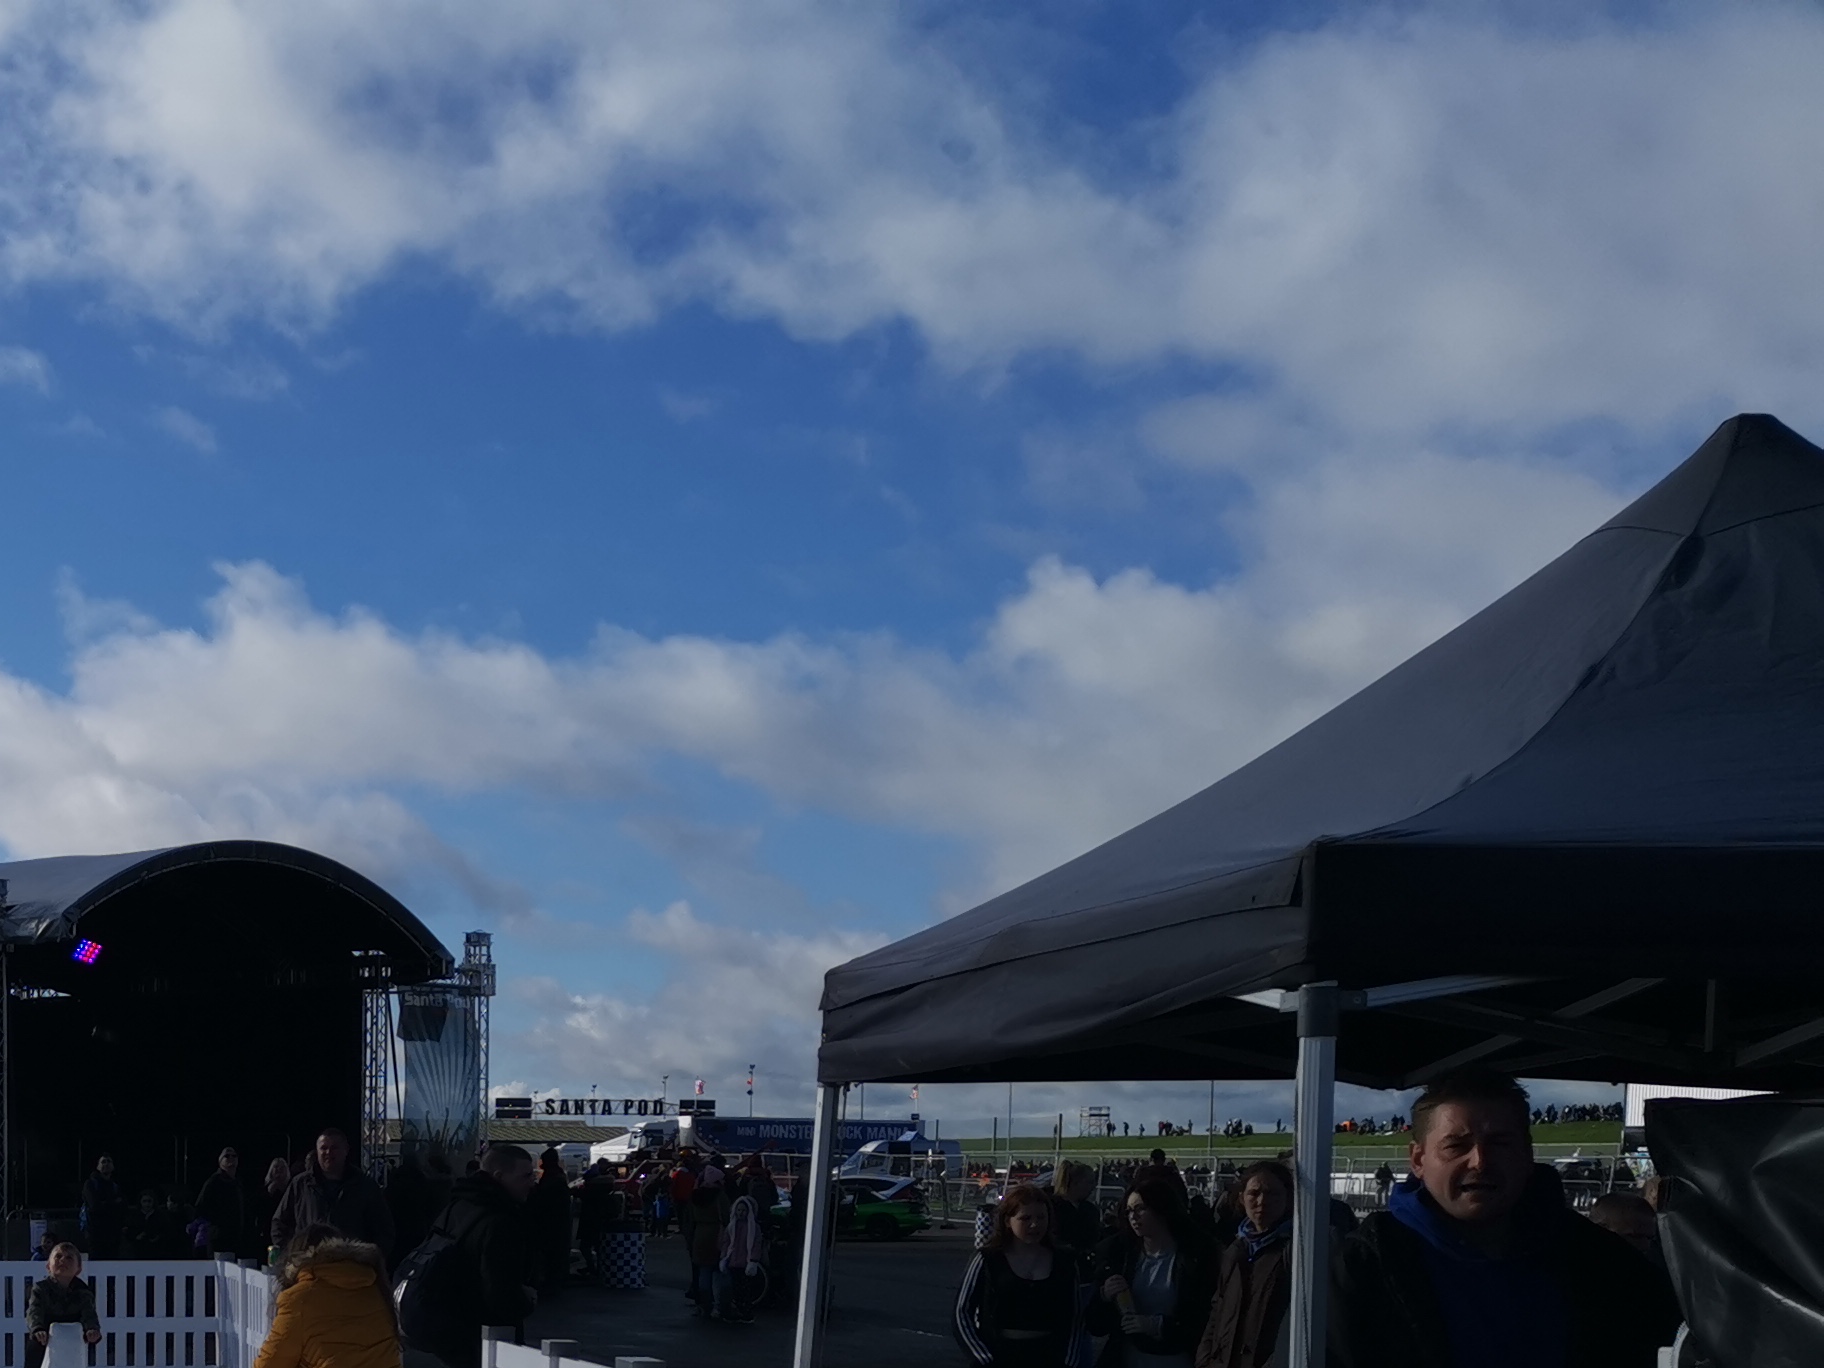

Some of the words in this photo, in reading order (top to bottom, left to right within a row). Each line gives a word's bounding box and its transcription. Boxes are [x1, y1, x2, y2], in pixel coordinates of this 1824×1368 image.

[404, 991, 444, 1007] Santa
[545, 1098, 612, 1115] SANTA
[624, 1099, 664, 1116] POD
[759, 1124, 814, 1139] MONSTE
